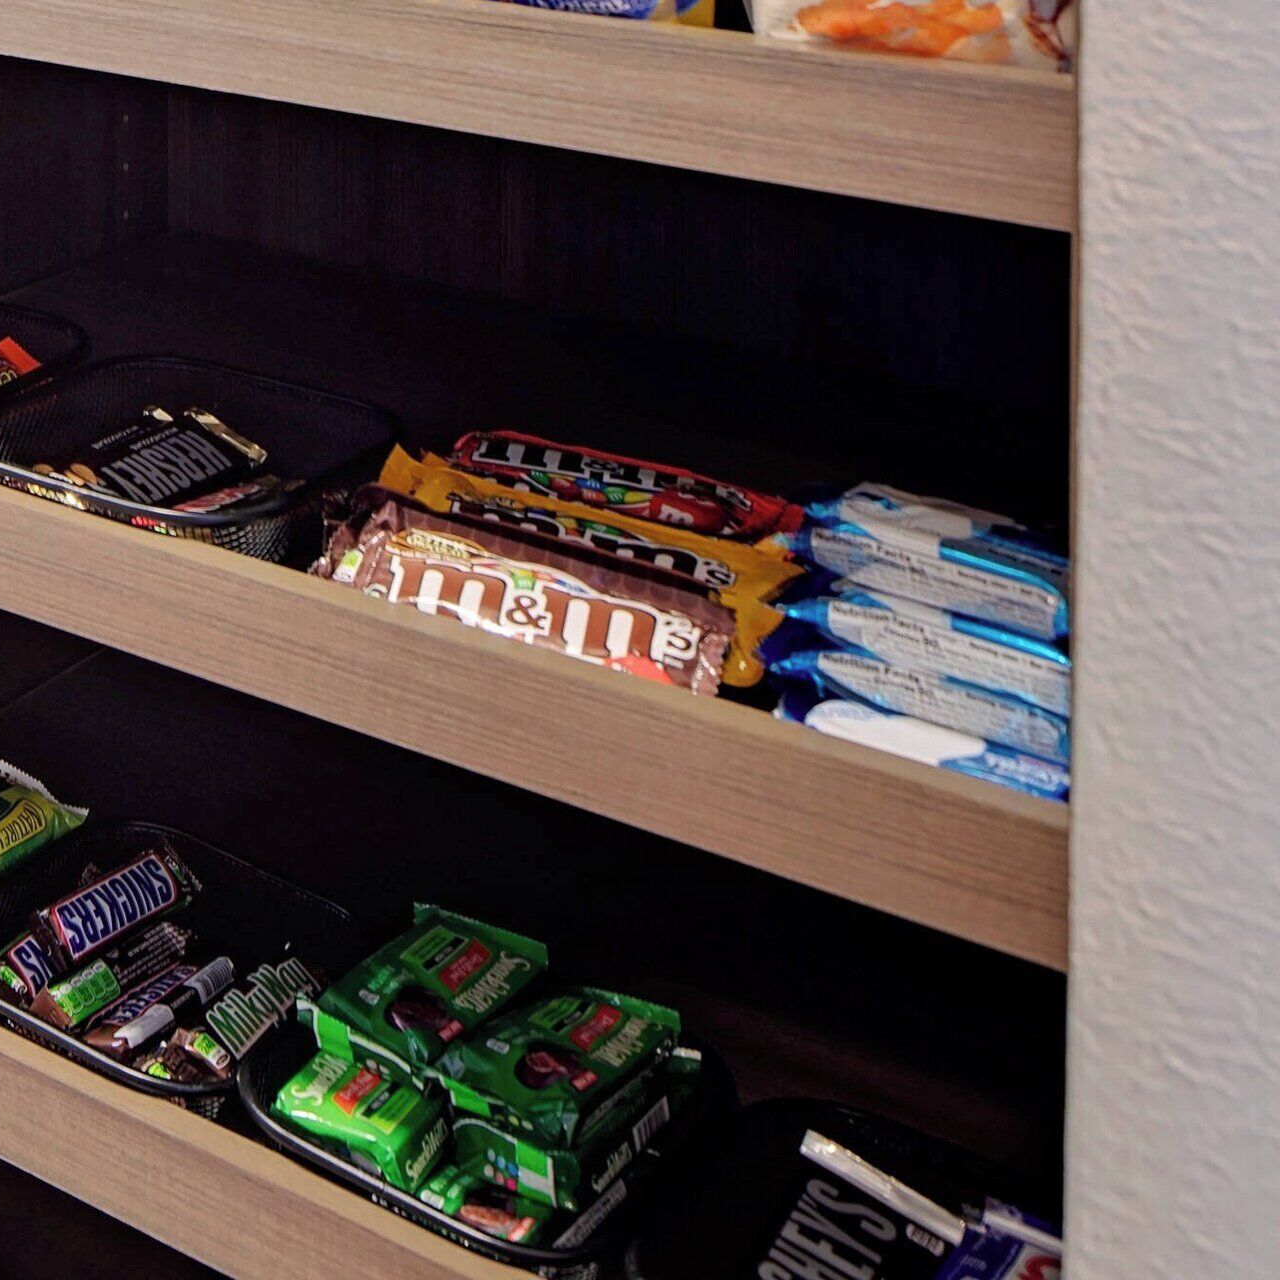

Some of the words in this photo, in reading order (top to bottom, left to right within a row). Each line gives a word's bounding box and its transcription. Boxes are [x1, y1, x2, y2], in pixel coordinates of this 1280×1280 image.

[832, 604, 890, 622] Nutrition
[892, 616, 926, 633] Facts
[822, 652, 880, 671] Nutrition
[884, 665, 920, 684] Facts
[3, 805, 42, 847] NATURE
[57, 854, 175, 959] SNICKERS
[205, 988, 278, 1061] Milky
[247, 956, 323, 1022] Way
